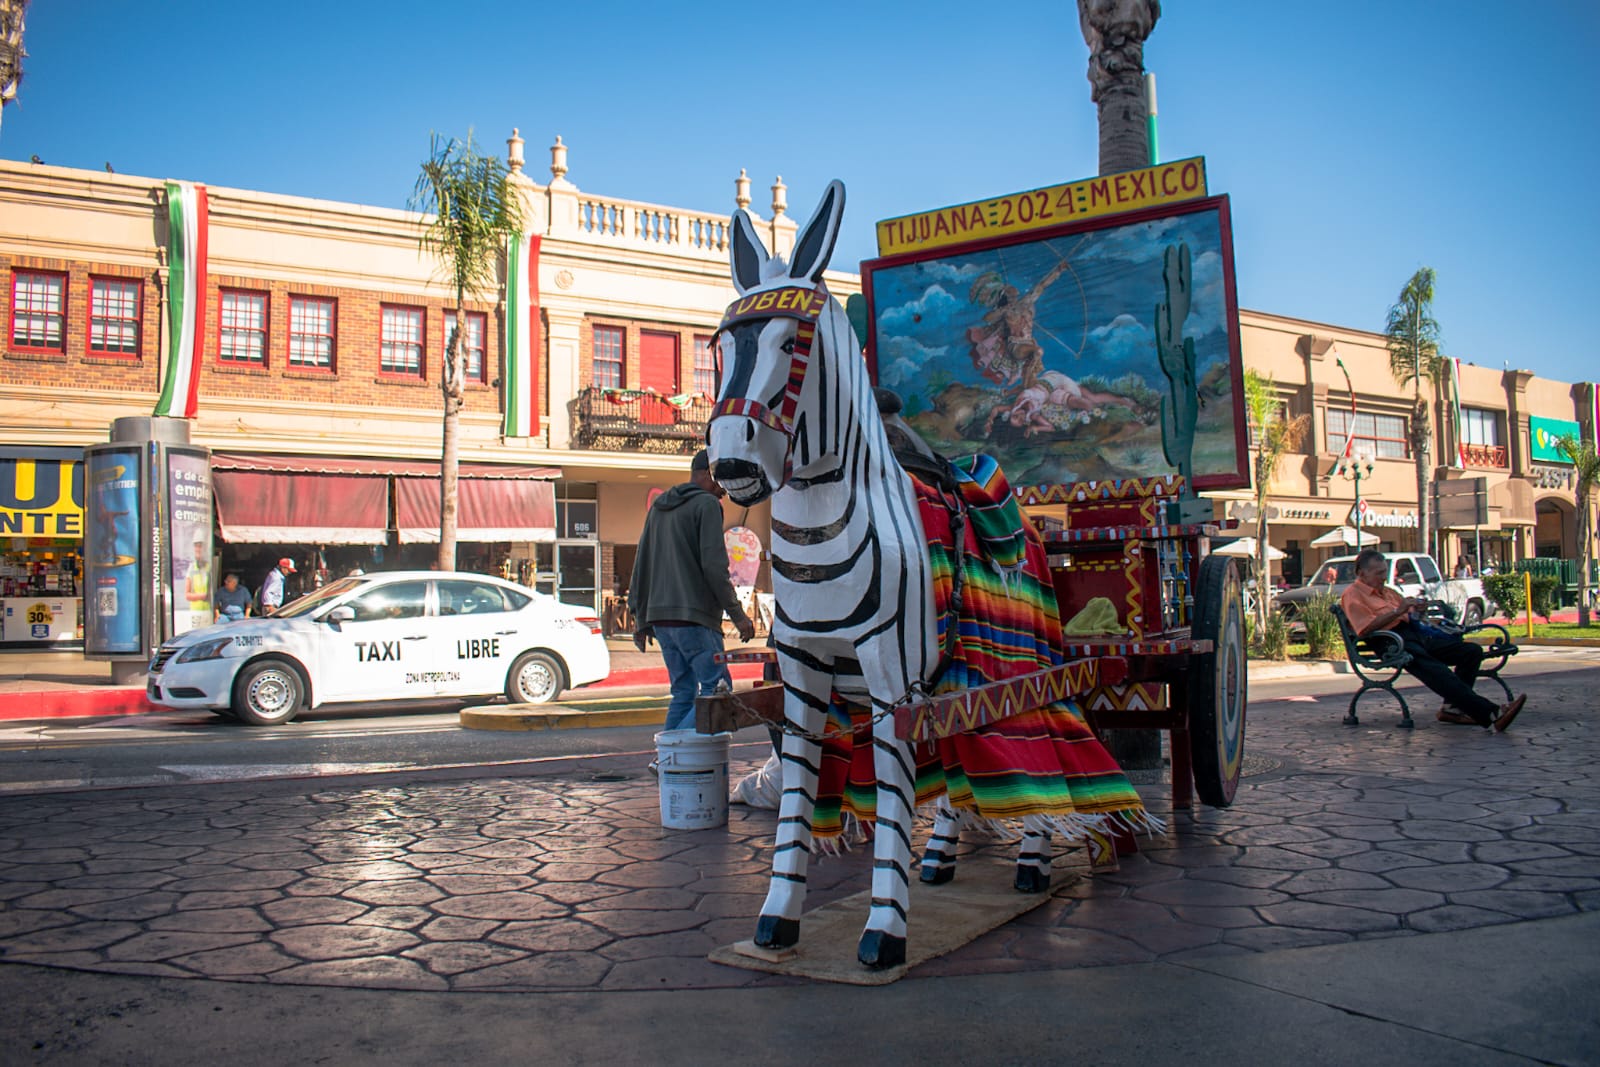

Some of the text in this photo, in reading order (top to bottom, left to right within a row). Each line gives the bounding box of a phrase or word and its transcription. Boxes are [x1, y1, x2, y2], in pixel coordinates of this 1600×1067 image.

[884, 162, 1199, 247] TIJUANA 2024 MEXICO
[726, 289, 813, 320] UBEN
[0, 459, 84, 510] U
[1365, 507, 1419, 528] Domino's
[354, 637, 500, 662] TAXI LIBRE
[405, 672, 420, 684] ZONA
